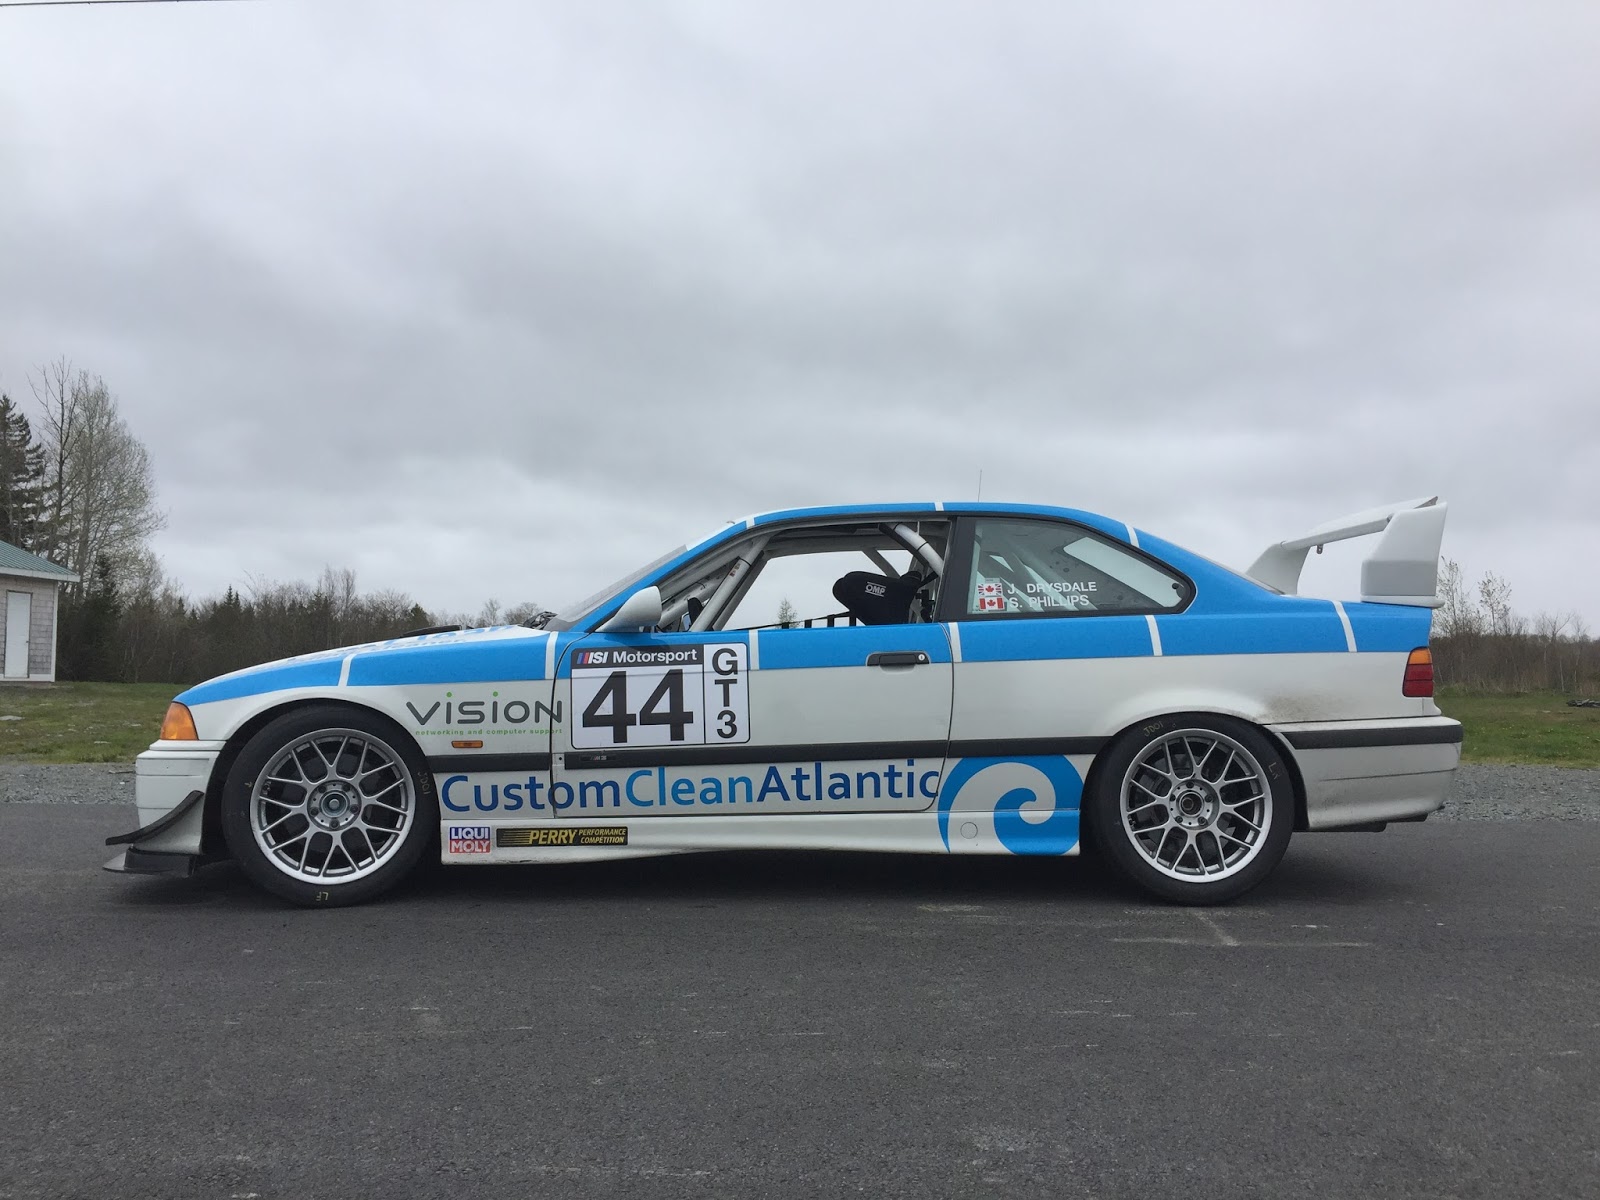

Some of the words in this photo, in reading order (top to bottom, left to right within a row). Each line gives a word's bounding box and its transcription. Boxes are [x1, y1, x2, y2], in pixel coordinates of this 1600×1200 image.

[865, 584, 886, 595] OMP
[1026, 581, 1098, 594] DRYSDALE
[1009, 597, 1023, 608] S.
[1029, 594, 1090, 608] PHILLIPS
[612, 649, 698, 664] Motorsport
[582, 668, 694, 744] 44
[486, 728, 527, 736] computer
[529, 728, 563, 736] support
[450, 827, 489, 840] LIQUI
[528, 829, 577, 845] PERRY
[578, 828, 627, 836] PERFORMANCE
[580, 836, 625, 844] COMPETITION
[450, 840, 490, 853] MOLY
